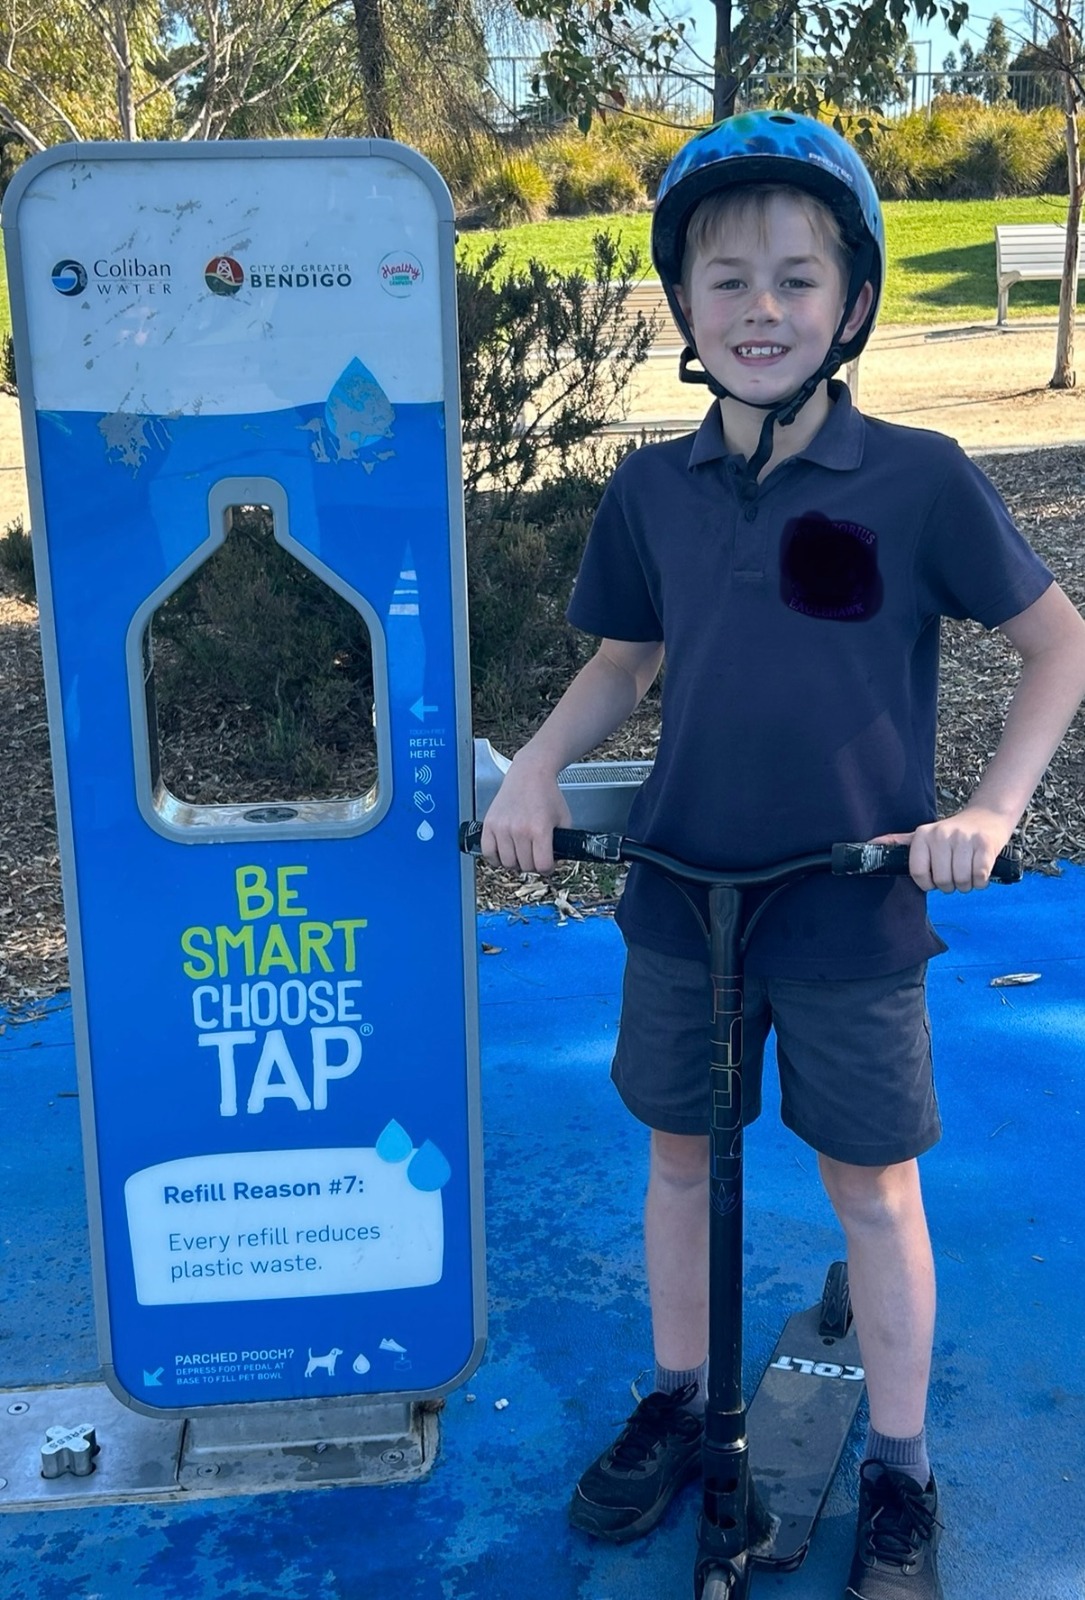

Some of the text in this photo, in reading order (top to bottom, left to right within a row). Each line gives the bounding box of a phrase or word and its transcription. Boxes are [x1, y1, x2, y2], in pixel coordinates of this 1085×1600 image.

[93, 258, 172, 278] Coliban
[249, 263, 351, 273] CITY OF GREATER
[381, 262, 421, 281] Healthy
[97, 283, 172, 295] WATER
[250, 273, 352, 288] BENDIGO
[409, 738, 445, 747] REFILL
[410, 750, 436, 759] HERE
[235, 865, 308, 921] BE
[181, 919, 368, 980] SMART
[192, 979, 363, 1029] CHOOSE
[163, 1175, 364, 1204] Refill Reason #7:
[168, 1223, 381, 1253] Every refill reduces
[170, 1255, 321, 1282] plastic waste.
[175, 1348, 295, 1365] PARCHED POOCH?
[175, 1361, 285, 1376] DEPRESS FOOT PEDAL AT
[769, 1355, 865, 1381] COLT
[176, 1371, 282, 1386] BASE TO FILL PET BOWL
[49, 1427, 87, 1449] PRESS
